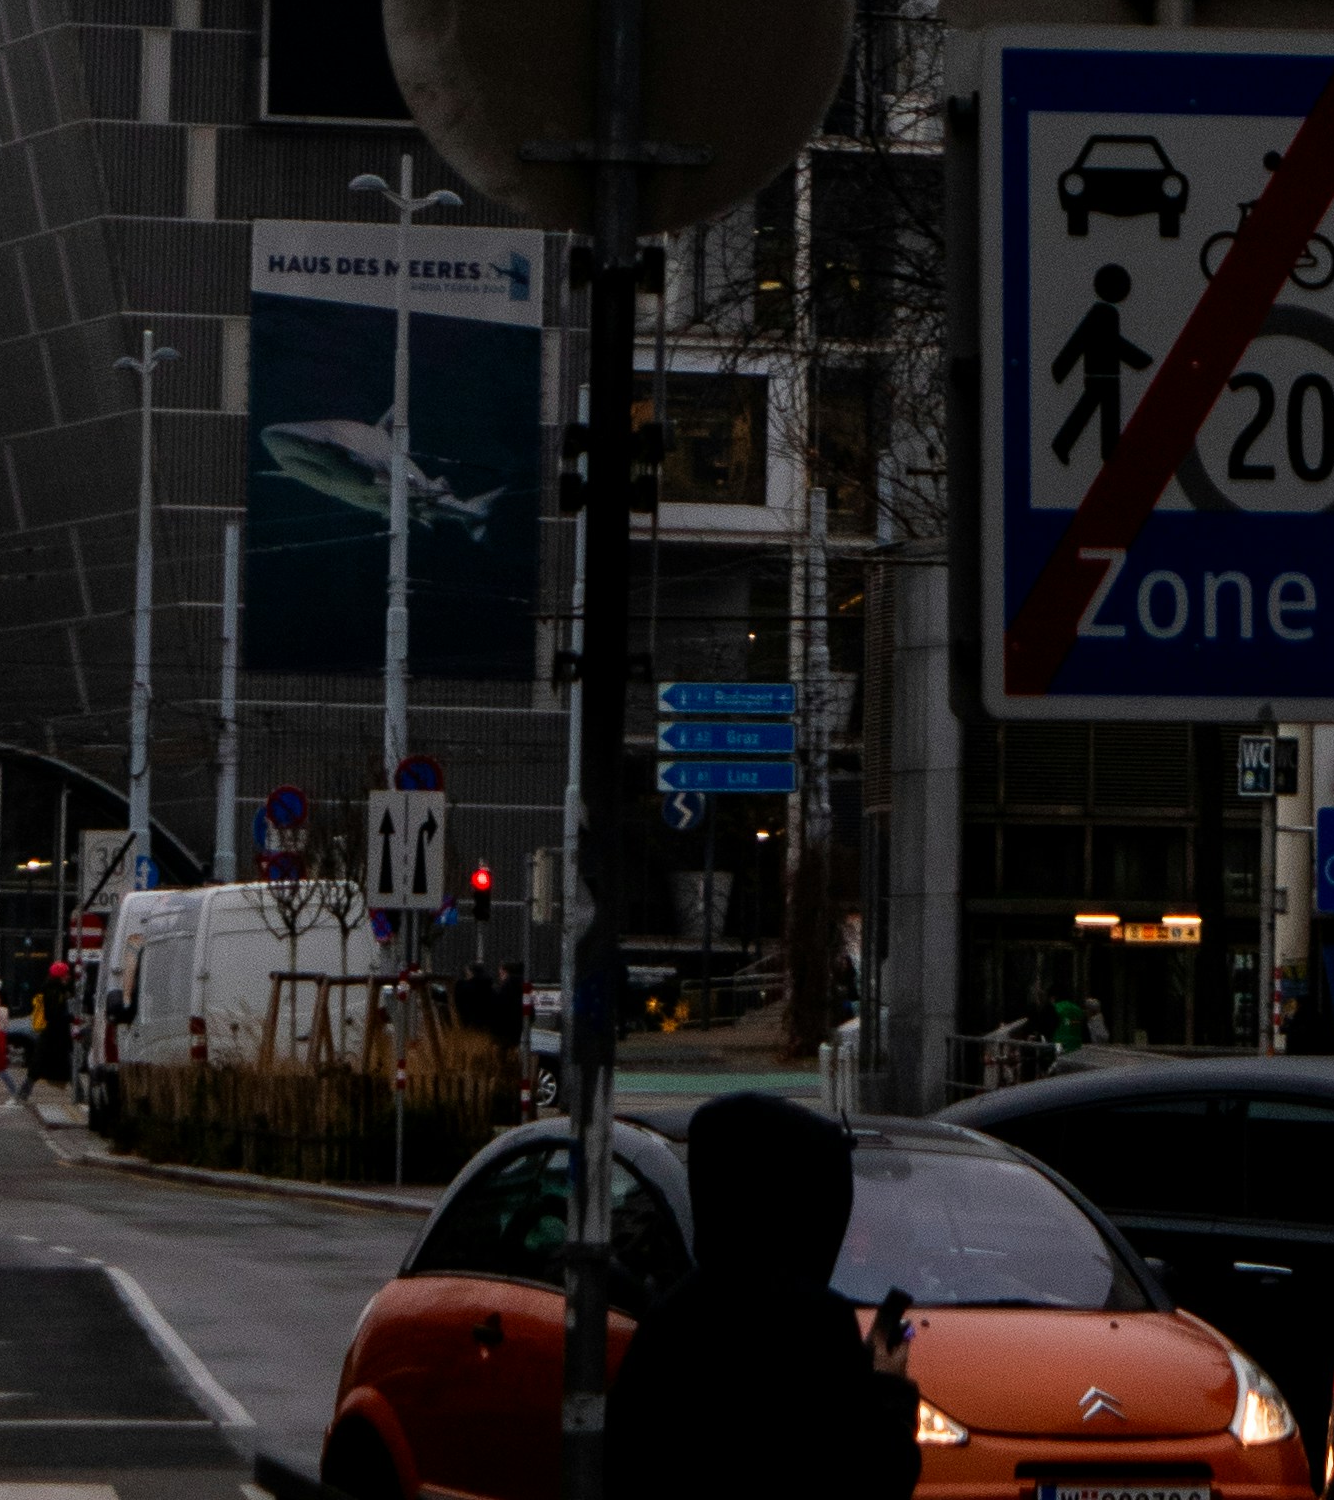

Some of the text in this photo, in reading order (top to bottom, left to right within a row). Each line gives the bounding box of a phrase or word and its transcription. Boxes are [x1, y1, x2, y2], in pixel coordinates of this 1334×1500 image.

[269, 254, 330, 274] HAUS
[336, 257, 379, 276] DES
[1076, 547, 1318, 641] Zone
[726, 729, 760, 745] Graz
[1242, 742, 1271, 768] WC
[727, 769, 759, 784] Linz
